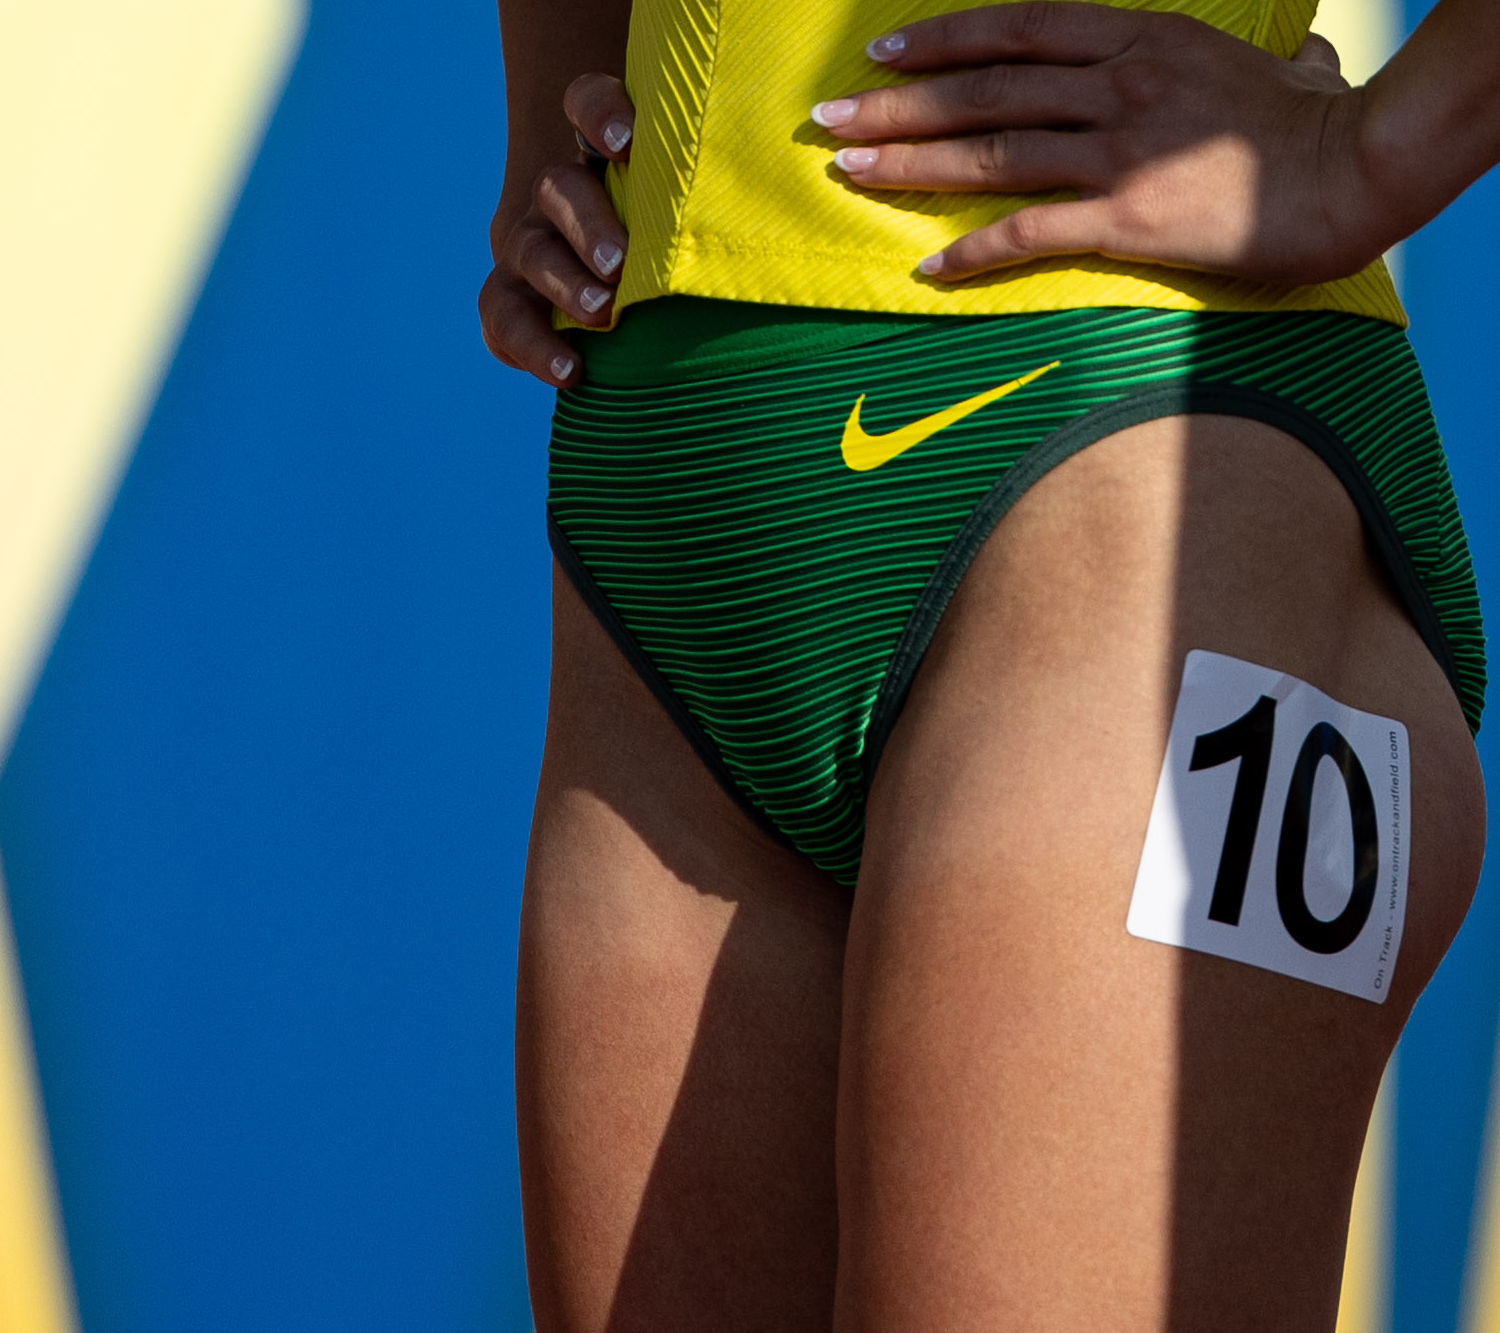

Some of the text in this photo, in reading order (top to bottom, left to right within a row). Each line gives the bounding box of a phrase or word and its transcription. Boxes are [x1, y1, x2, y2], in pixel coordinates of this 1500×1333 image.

[1188, 694, 1379, 955] 10
[1378, 925, 1394, 964] Track
[1373, 969, 1384, 990] On
